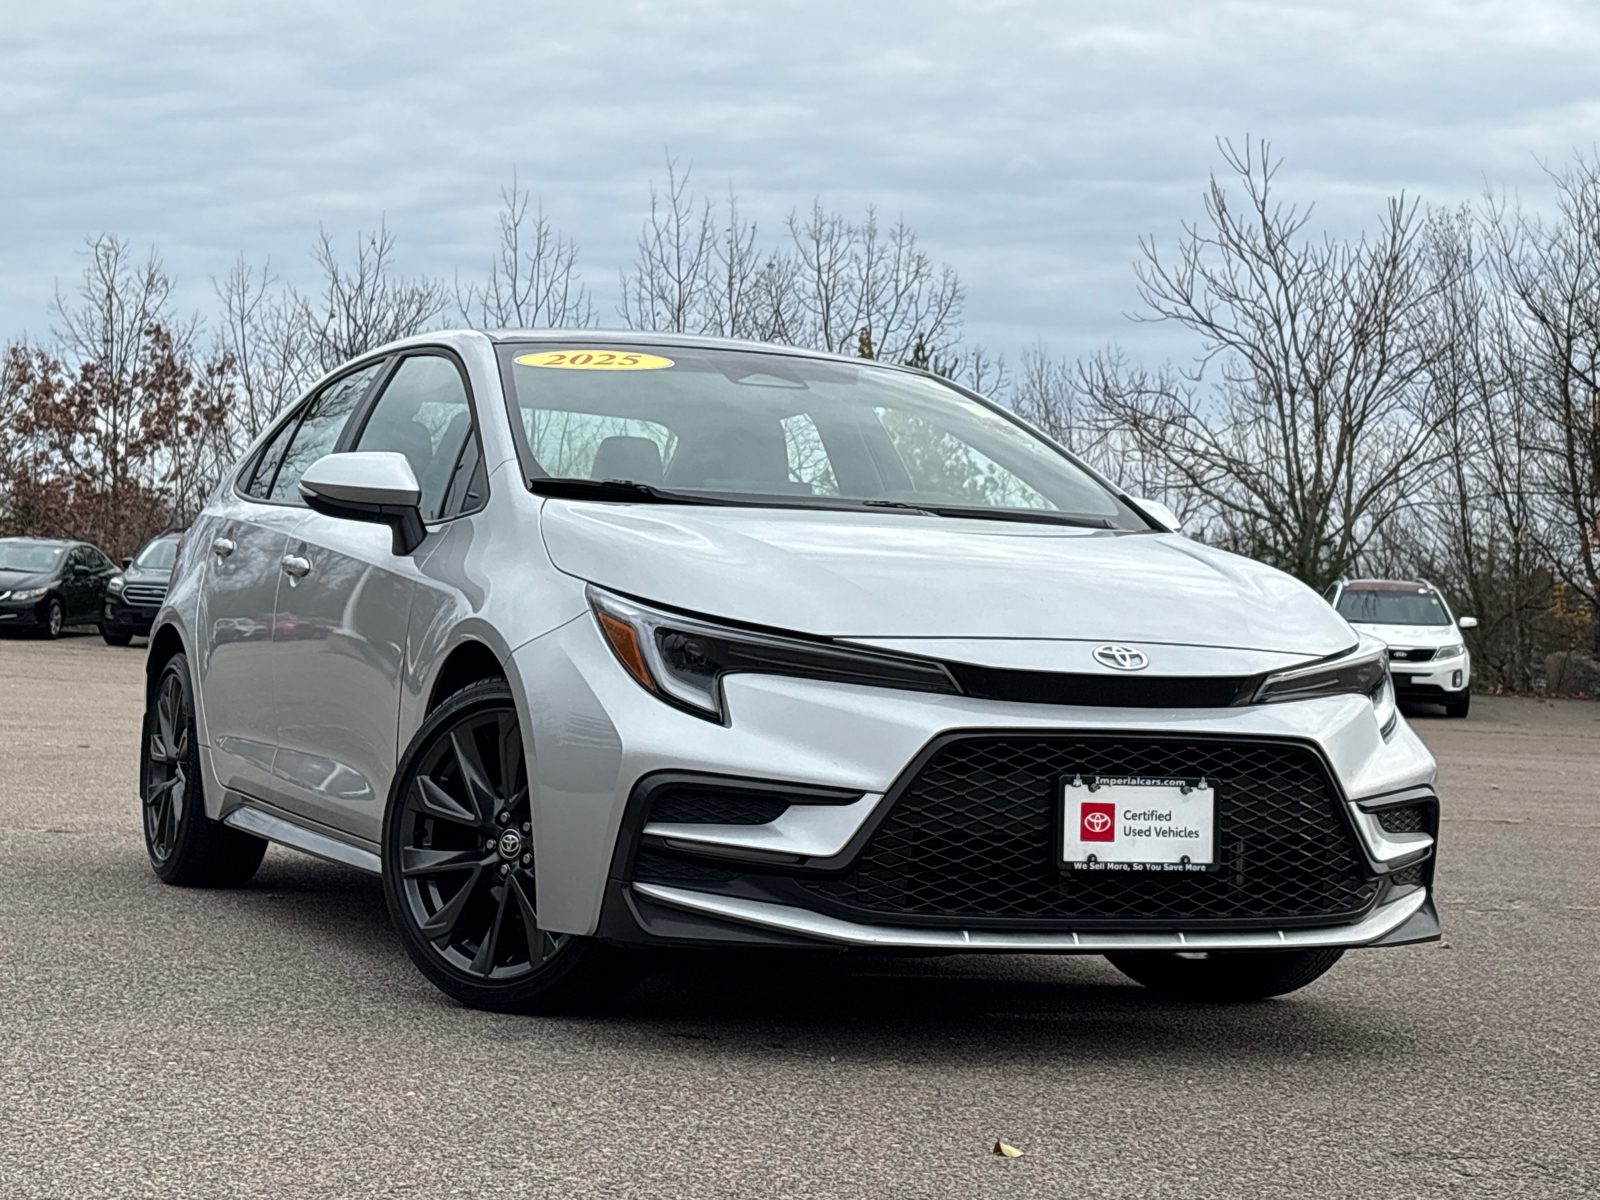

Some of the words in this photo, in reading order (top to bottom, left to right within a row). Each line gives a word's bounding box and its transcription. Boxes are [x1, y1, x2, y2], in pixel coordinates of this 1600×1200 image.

[542, 353, 643, 366] 2025
[1095, 776, 1186, 787] Imperialcars.com
[1123, 809, 1172, 822] Certified
[1123, 826, 1151, 837] Used
[1154, 827, 1200, 838] Vehicles
[1074, 862, 1088, 870] We
[1089, 862, 1105, 870] Sell
[1107, 862, 1131, 872] More,
[1132, 863, 1144, 871] So
[1146, 863, 1161, 871] You
[1163, 864, 1184, 872] Save
[1185, 864, 1207, 872] More
